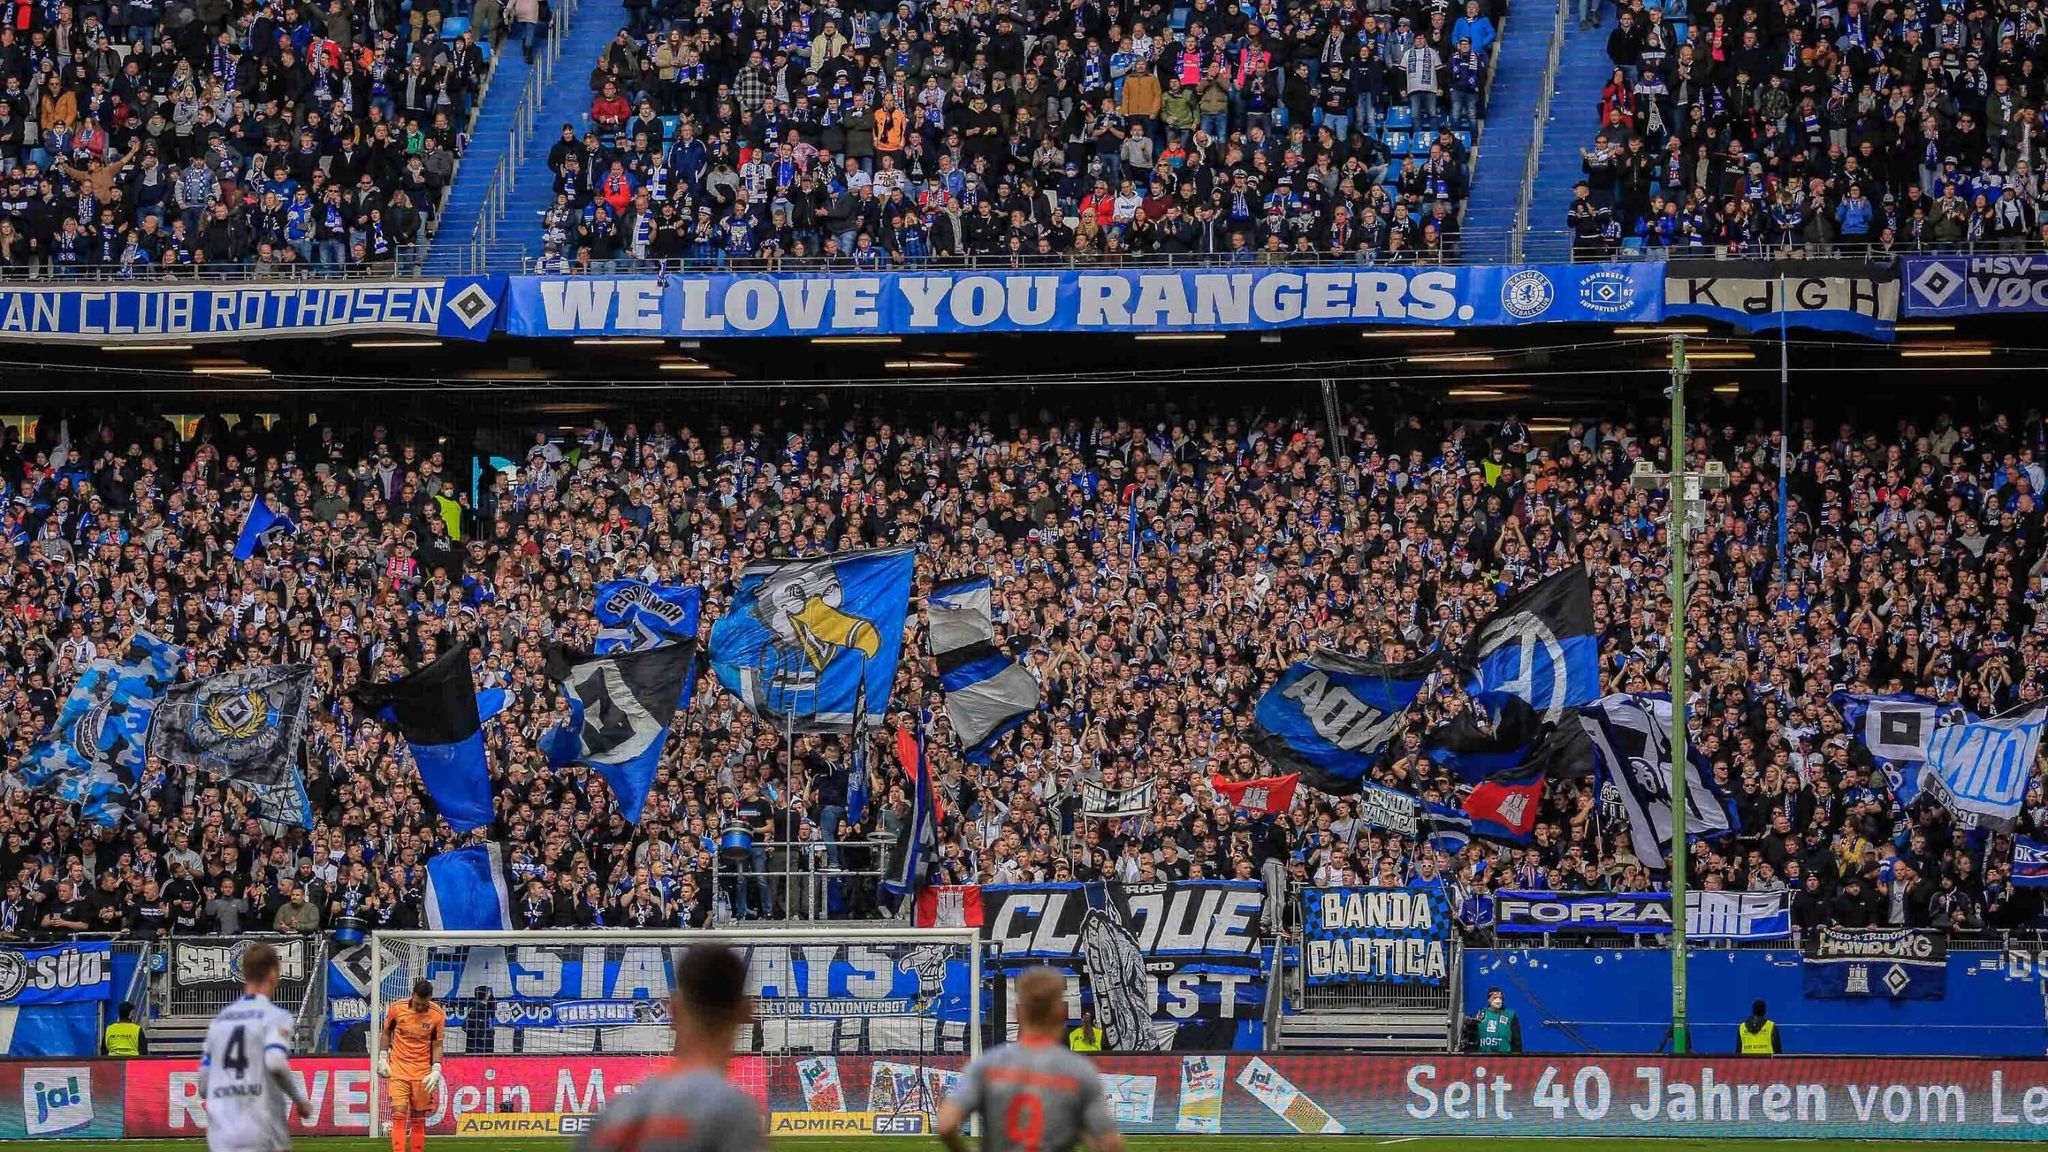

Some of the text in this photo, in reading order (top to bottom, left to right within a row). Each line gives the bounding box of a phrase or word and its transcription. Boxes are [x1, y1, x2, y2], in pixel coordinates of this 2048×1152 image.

[1508, 271, 1548, 287] RANGERS
[1580, 272, 1624, 286] HAMBURGER
[541, 272, 1475, 331] WE LOVE YOU RANGERS.
[1580, 289, 1590, 297] 18
[0, 286, 444, 334] AN CLUB ROTHOSEN
[1505, 297, 1550, 316] FOOTBALL CLUB
[1580, 300, 1634, 312] SUPPORTERS CLUB
[1123, 884, 1167, 894] RAS
[1322, 892, 1432, 929] BANDA
[1501, 902, 1672, 923] FORZA
[1817, 932, 1932, 957] HAMBURG
[35, 949, 102, 990] SÜD
[1308, 938, 1447, 978] CAOTICA
[753, 1001, 908, 1015] SEKTION STADIONVERBOT
[223, 1024, 249, 1080] 4
[34, 1076, 81, 1124] ja!
[169, 1070, 371, 1128] RWE
[1406, 1065, 1514, 1119] Seit
[1533, 1066, 1612, 1120] 40
[1630, 1066, 1826, 1121] Jahren
[1847, 1083, 1966, 1123] vom
[463, 1118, 557, 1132] ADMIRAL
[561, 1118, 602, 1134] BE
[777, 1117, 920, 1131] ADMIRAL BET
[1004, 1091, 1046, 1152] 9
